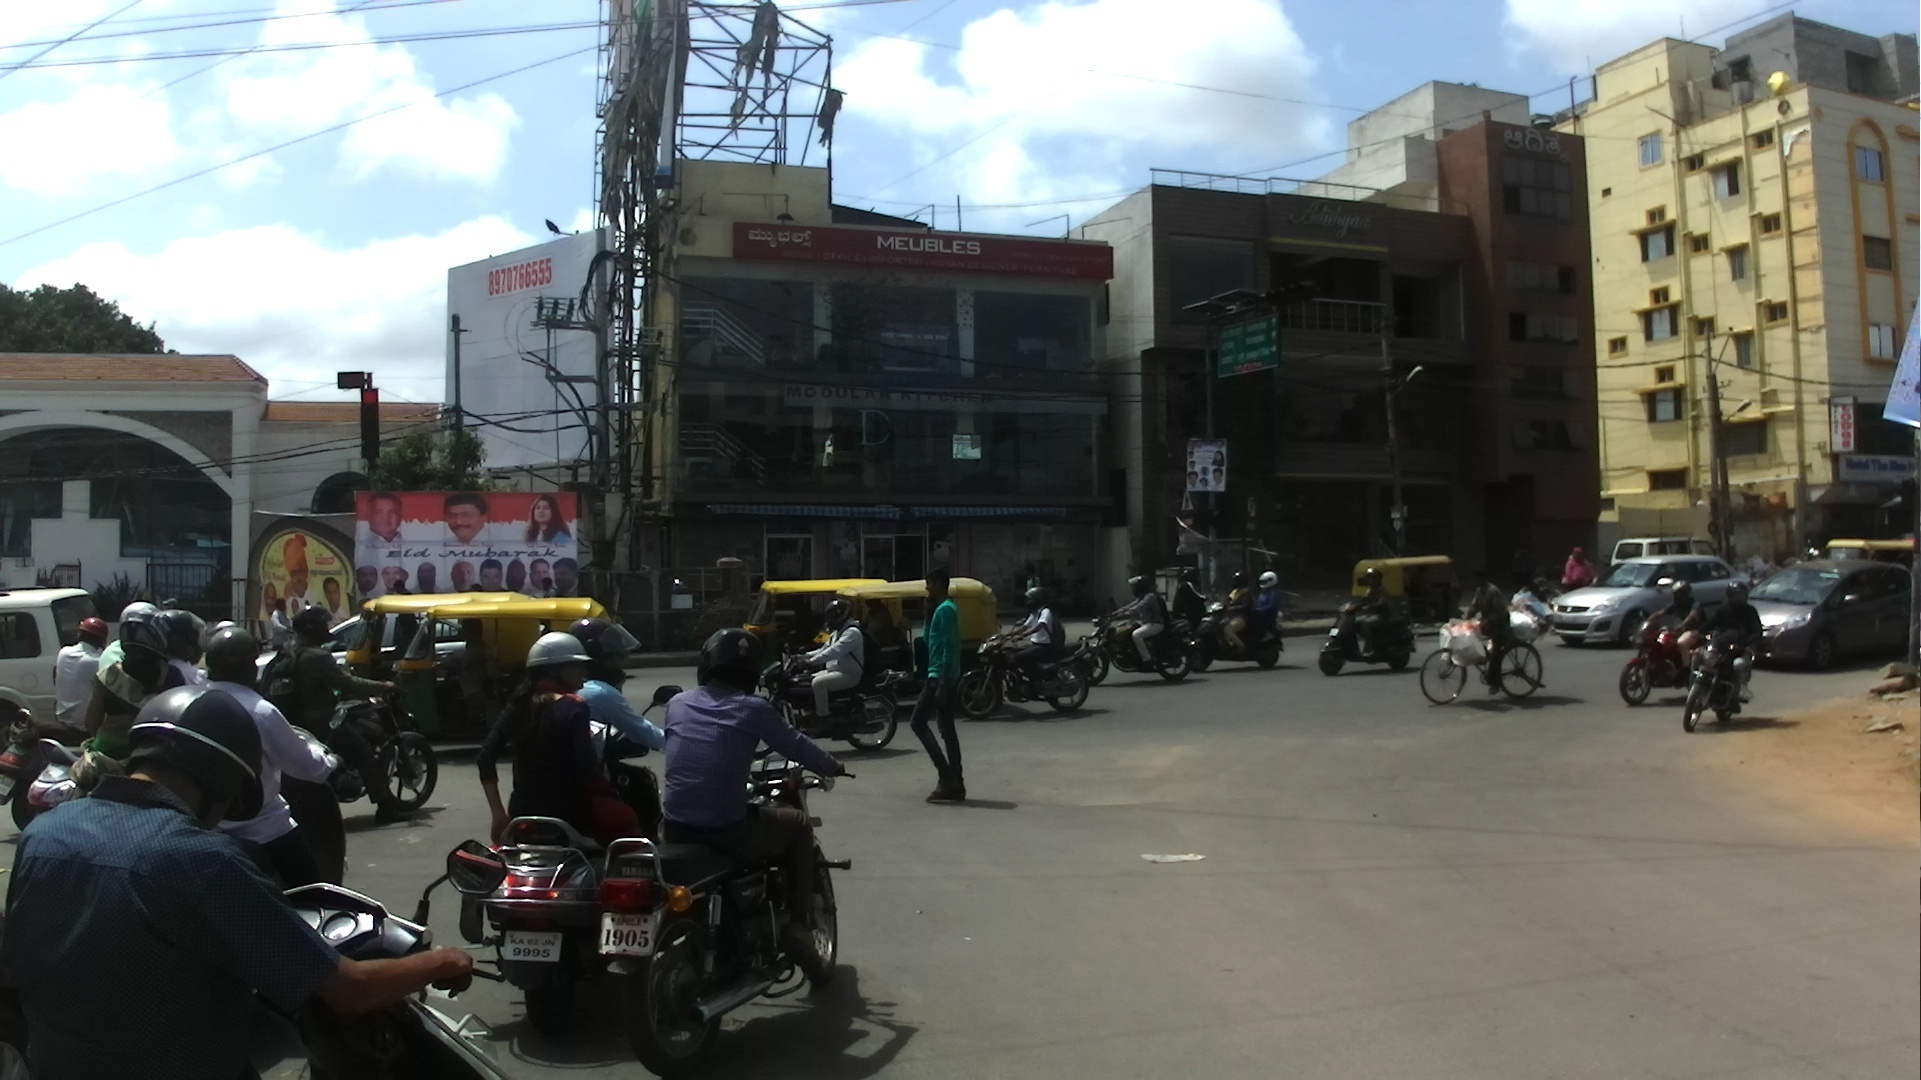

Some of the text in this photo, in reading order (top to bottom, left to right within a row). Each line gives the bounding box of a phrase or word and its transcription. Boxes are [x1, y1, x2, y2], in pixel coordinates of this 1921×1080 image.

[877, 235, 981, 255] MEUBLES
[488, 258, 552, 296] 8970766555
[786, 385, 993, 404] MODULAR KITCHEN
[386, 547, 431, 558] Eid
[438, 546, 559, 558] Mubarak
[621, 866, 654, 877] YAMAHA
[604, 929, 650, 948] 1905
[513, 947, 551, 958] 9995
